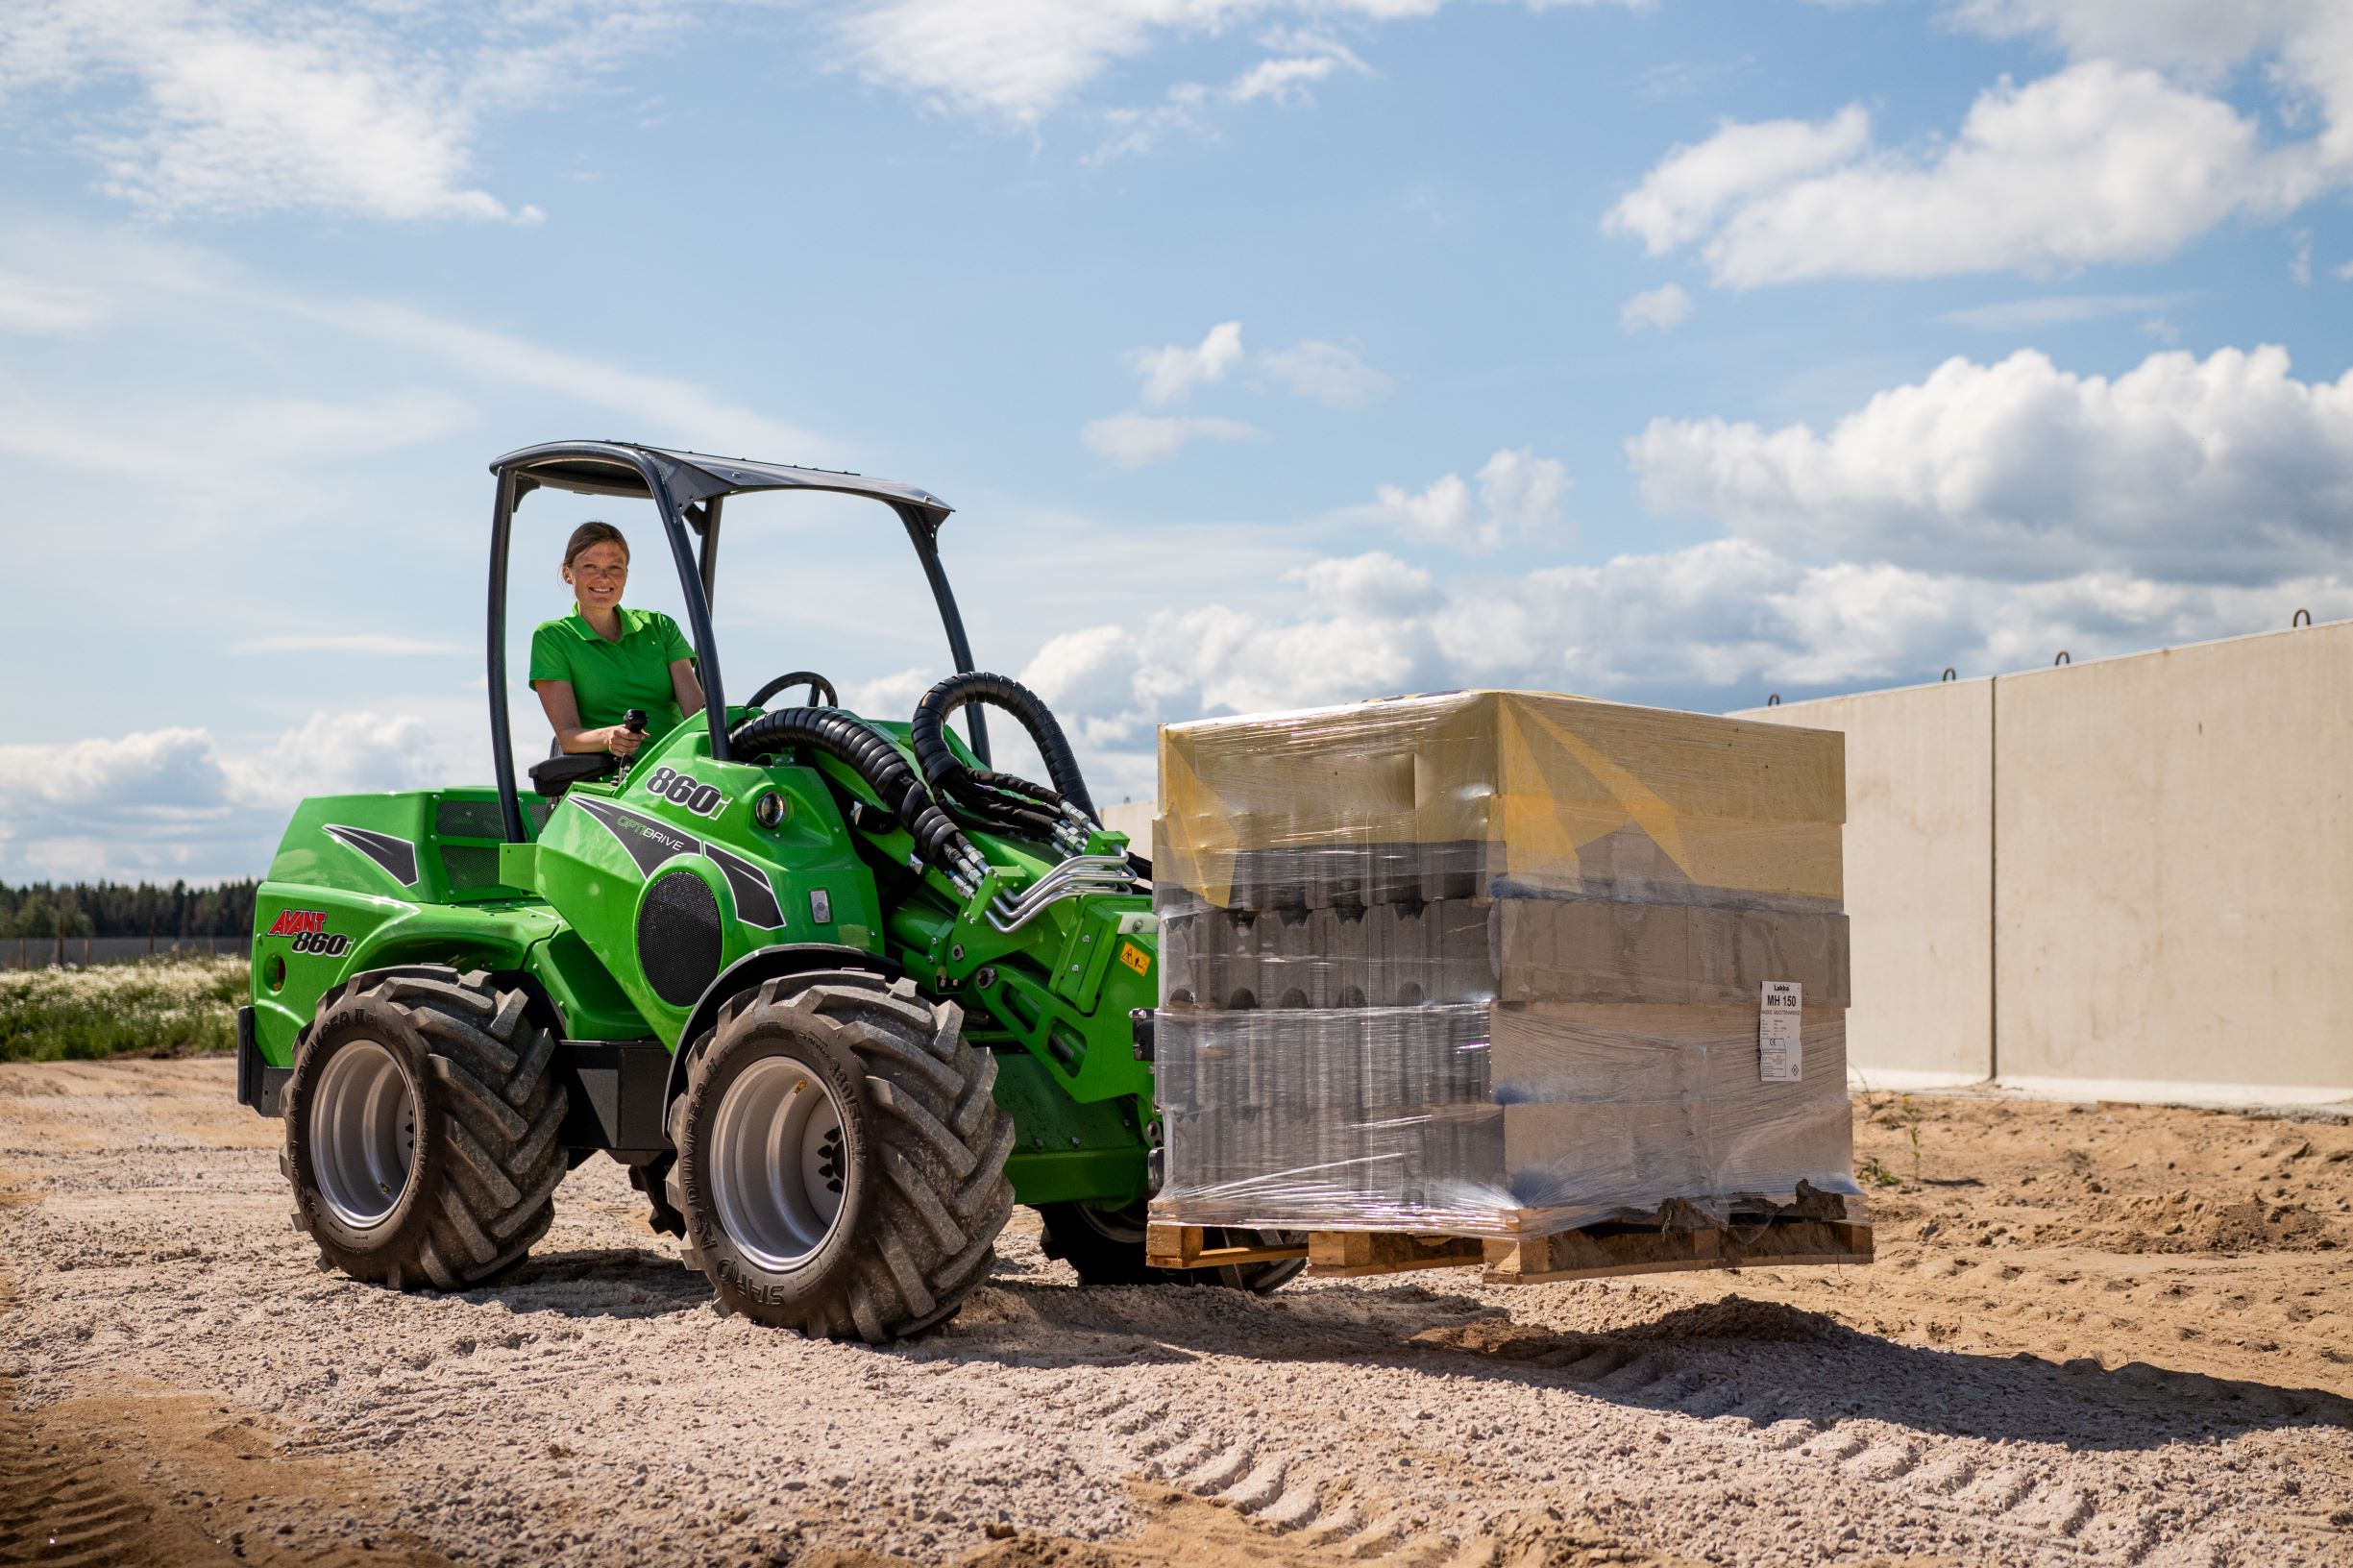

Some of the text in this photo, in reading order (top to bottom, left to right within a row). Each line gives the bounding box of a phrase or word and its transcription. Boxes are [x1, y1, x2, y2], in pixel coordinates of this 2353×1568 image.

[646, 766, 733, 821] 860i
[617, 815, 685, 851] OPTIDRIVE
[267, 908, 328, 937] AVANT
[291, 931, 356, 957] 860i
[1767, 994, 1797, 1007] MH 150
[682, 1084, 711, 1206] DUMPER
